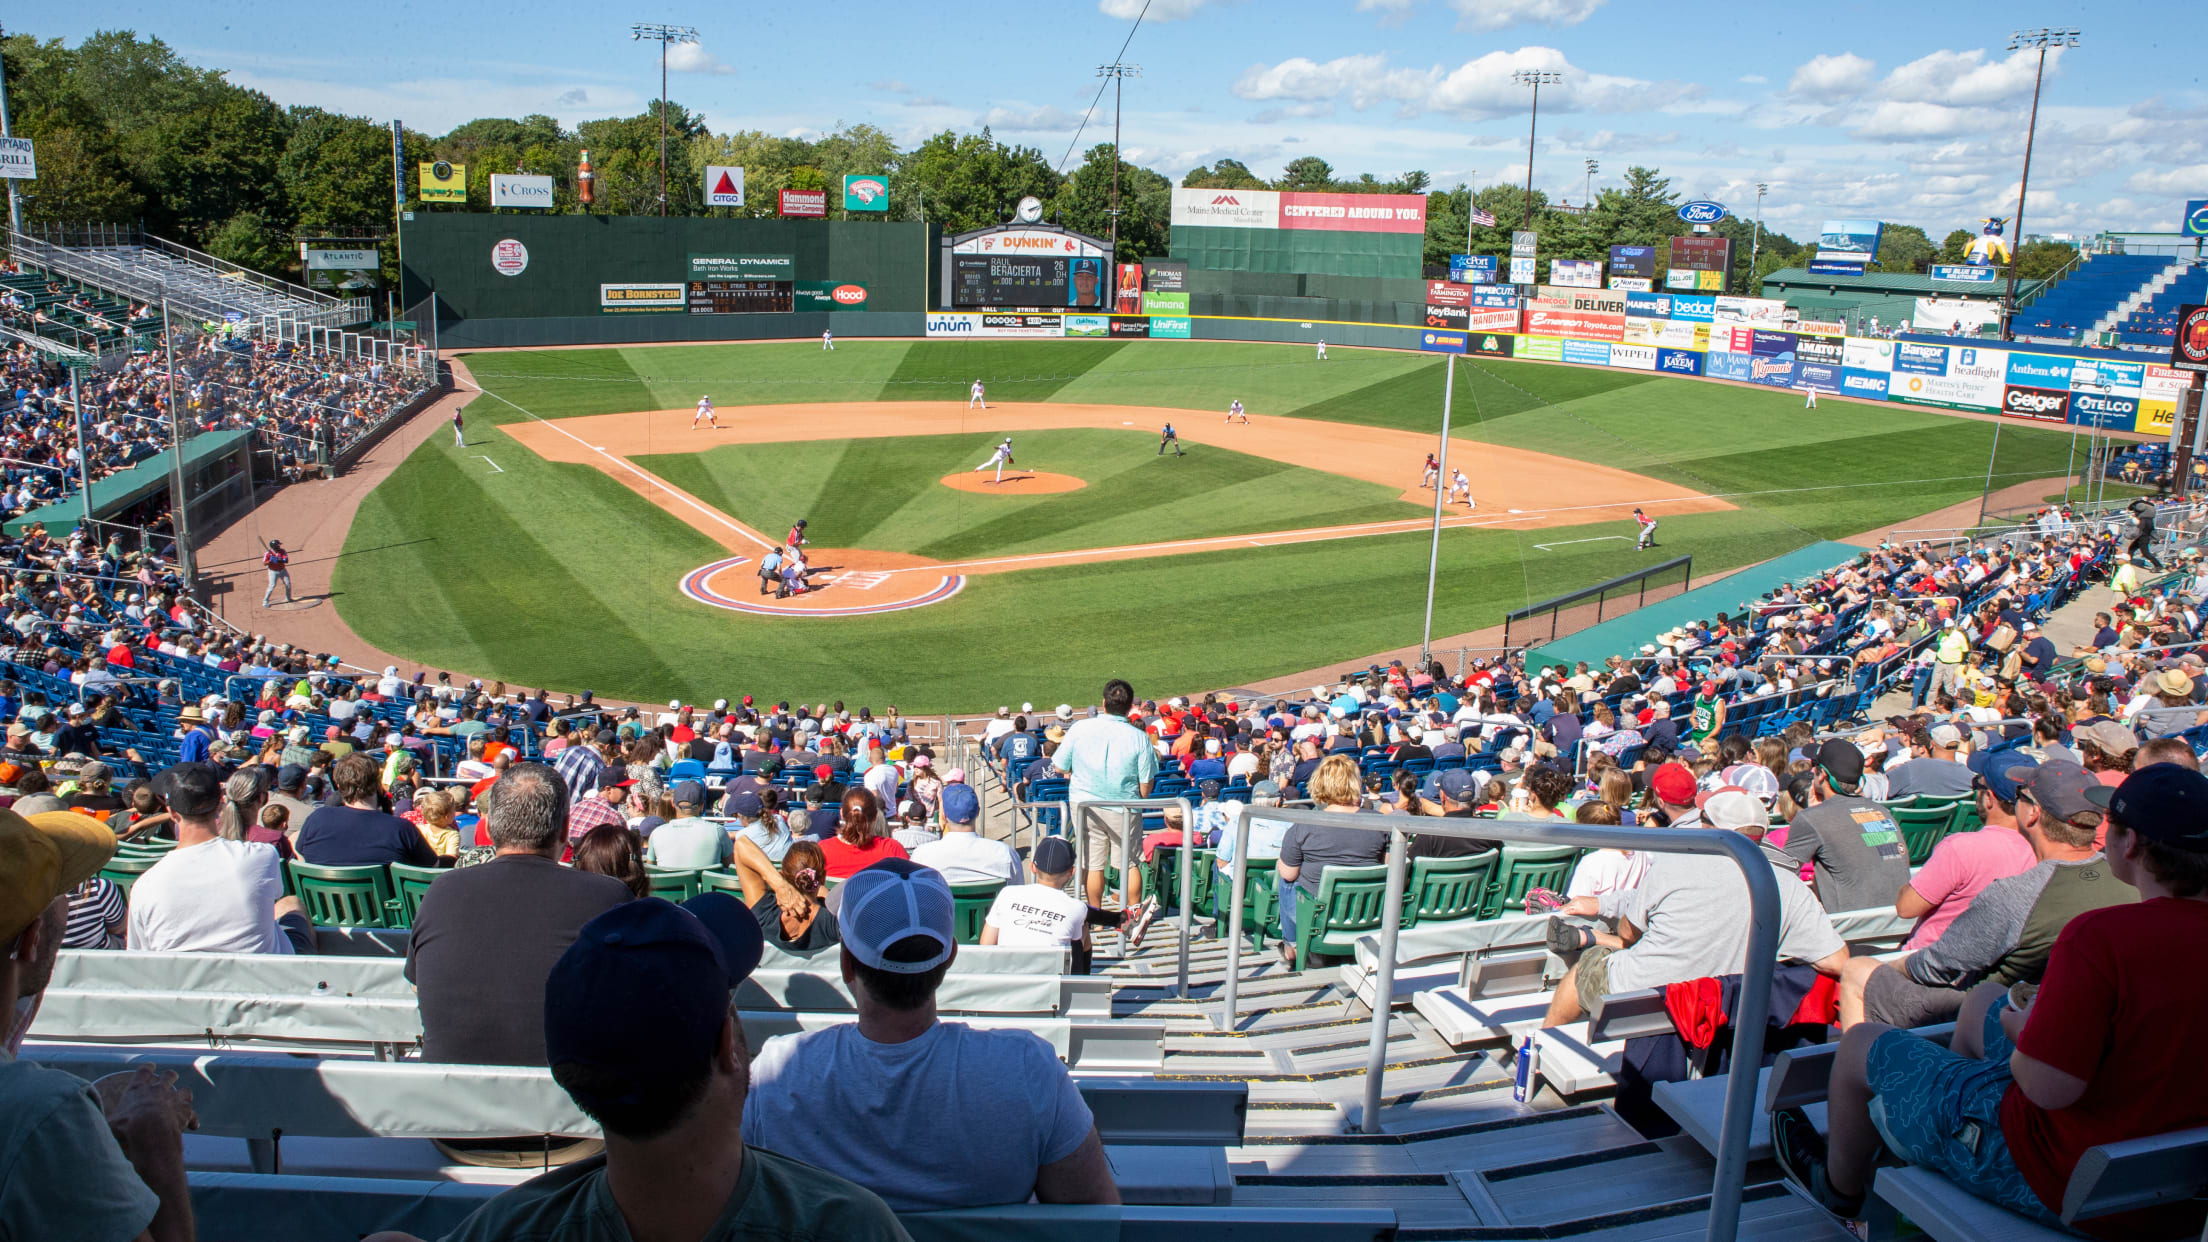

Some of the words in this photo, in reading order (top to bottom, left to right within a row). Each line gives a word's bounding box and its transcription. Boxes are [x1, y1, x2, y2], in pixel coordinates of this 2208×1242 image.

[0, 154, 31, 164] RILL
[713, 194, 738, 203] CITGO
[782, 192, 825, 204] Hammond
[1187, 206, 1210, 214] Maine
[1211, 206, 1239, 216] Medical
[1240, 207, 1263, 216] Center
[1284, 206, 1345, 218] CENTERED
[1348, 207, 1392, 220] AROUND
[1396, 208, 1421, 220] YOU.
[1686, 204, 1716, 220] Ford
[1003, 236, 1058, 248] DUNKIN'
[1054, 260, 1064, 270] 26
[1466, 256, 1488, 266] cPort
[990, 266, 1042, 276] BERACIERTA
[1056, 270, 1066, 278] DH
[1452, 272, 1460, 280] 94
[1486, 272, 1494, 281] 74
[1620, 279, 1646, 288] Norway
[1698, 278, 1721, 290] JOE
[607, 289, 624, 299] JOE
[626, 289, 680, 298] BORNSTEIN
[837, 290, 863, 300] Hood
[1430, 289, 1468, 297] FARMINGTON
[1474, 286, 1515, 296] SUPERCUTS
[1146, 299, 1185, 310] Humana
[1574, 299, 1624, 313] DELIVER
[1427, 306, 1467, 318] KeyBank
[1473, 312, 1514, 325] HANDYMAN
[928, 321, 972, 331] unum
[1153, 320, 1188, 330] UniFirst
[1583, 321, 1623, 331] Toyota.com
[1804, 324, 1843, 334] DUNKIN'
[1796, 342, 1843, 356] AMATO'S
[1901, 343, 1944, 359] Bangor
[1664, 355, 1694, 372] KAYEM
[1727, 354, 1749, 365] MANN
[1899, 353, 1924, 362] Savings
[1925, 356, 1944, 364] Bank
[1728, 365, 1745, 376] LAW
[1751, 358, 1794, 379] Wyman's
[1954, 365, 2000, 379] headlight
[2010, 363, 2047, 377] Anthem
[2075, 360, 2098, 369] Need
[2100, 361, 2142, 373] Propane?
[1844, 376, 1886, 391] MEMIC
[1962, 383, 1985, 392] POINT
[1926, 387, 1954, 397] HEALTH
[1955, 390, 1976, 399] CARE
[2007, 390, 2063, 412] Geiger
[2077, 396, 2133, 412] OTELCO
[1010, 902, 1040, 915] FLEET
[1041, 910, 1066, 922] FEET
